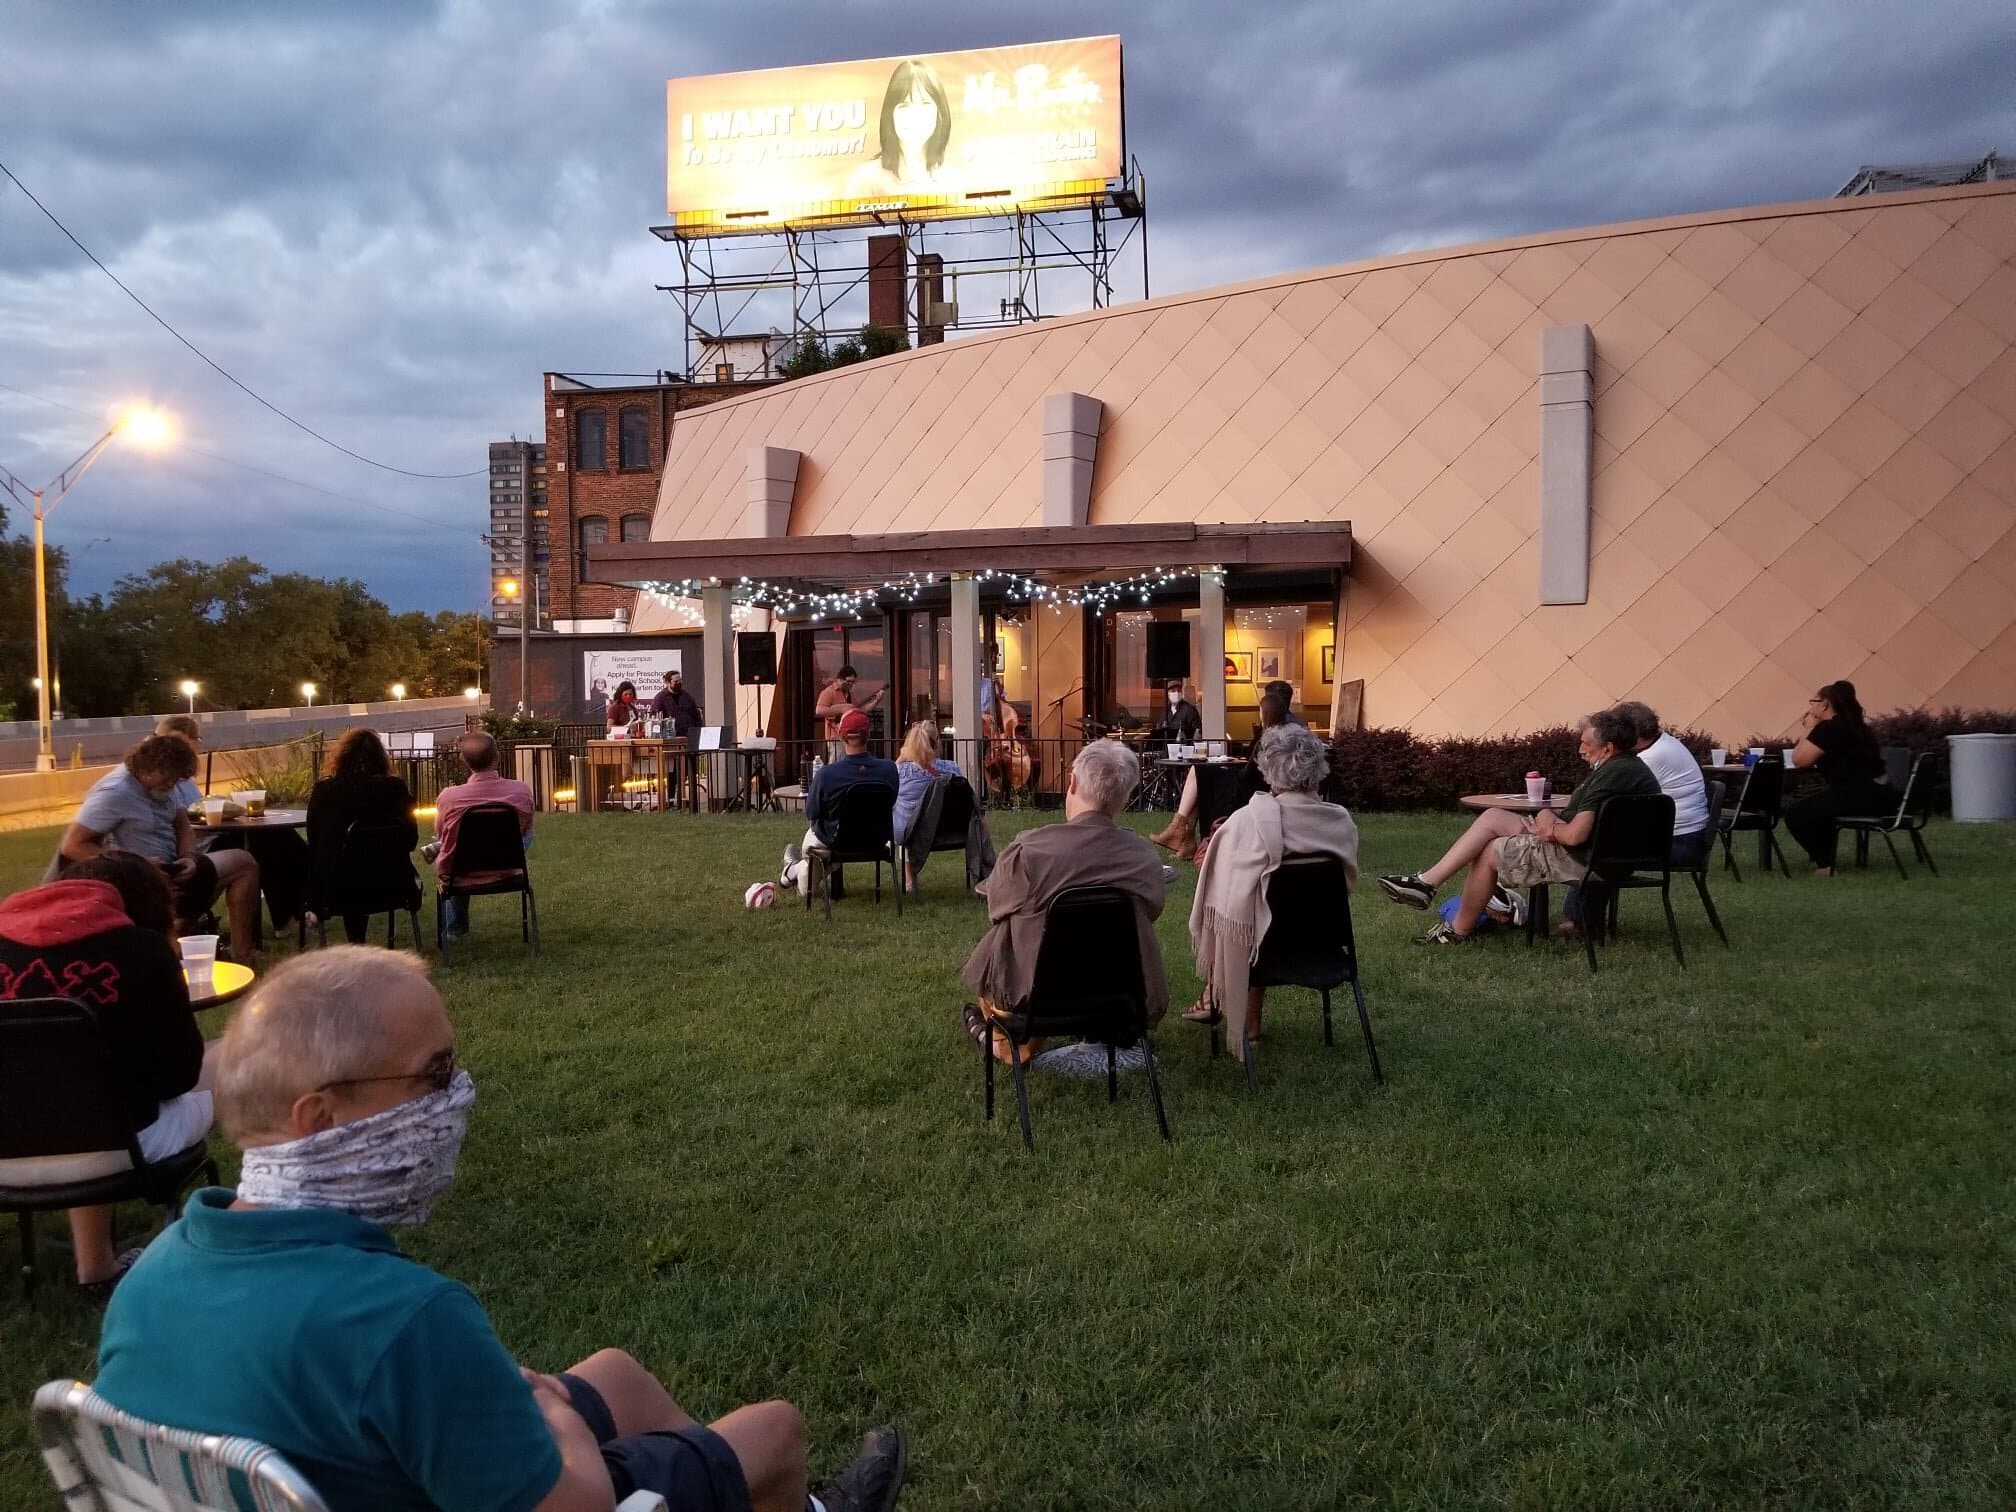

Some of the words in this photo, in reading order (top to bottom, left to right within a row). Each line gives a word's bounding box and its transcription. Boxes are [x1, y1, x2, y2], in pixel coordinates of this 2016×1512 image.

[682, 112, 695, 143] I
[702, 105, 797, 141] WANT
[803, 98, 869, 131] YOU
[684, 144, 705, 166] To
[607, 671, 625, 679] Apply
